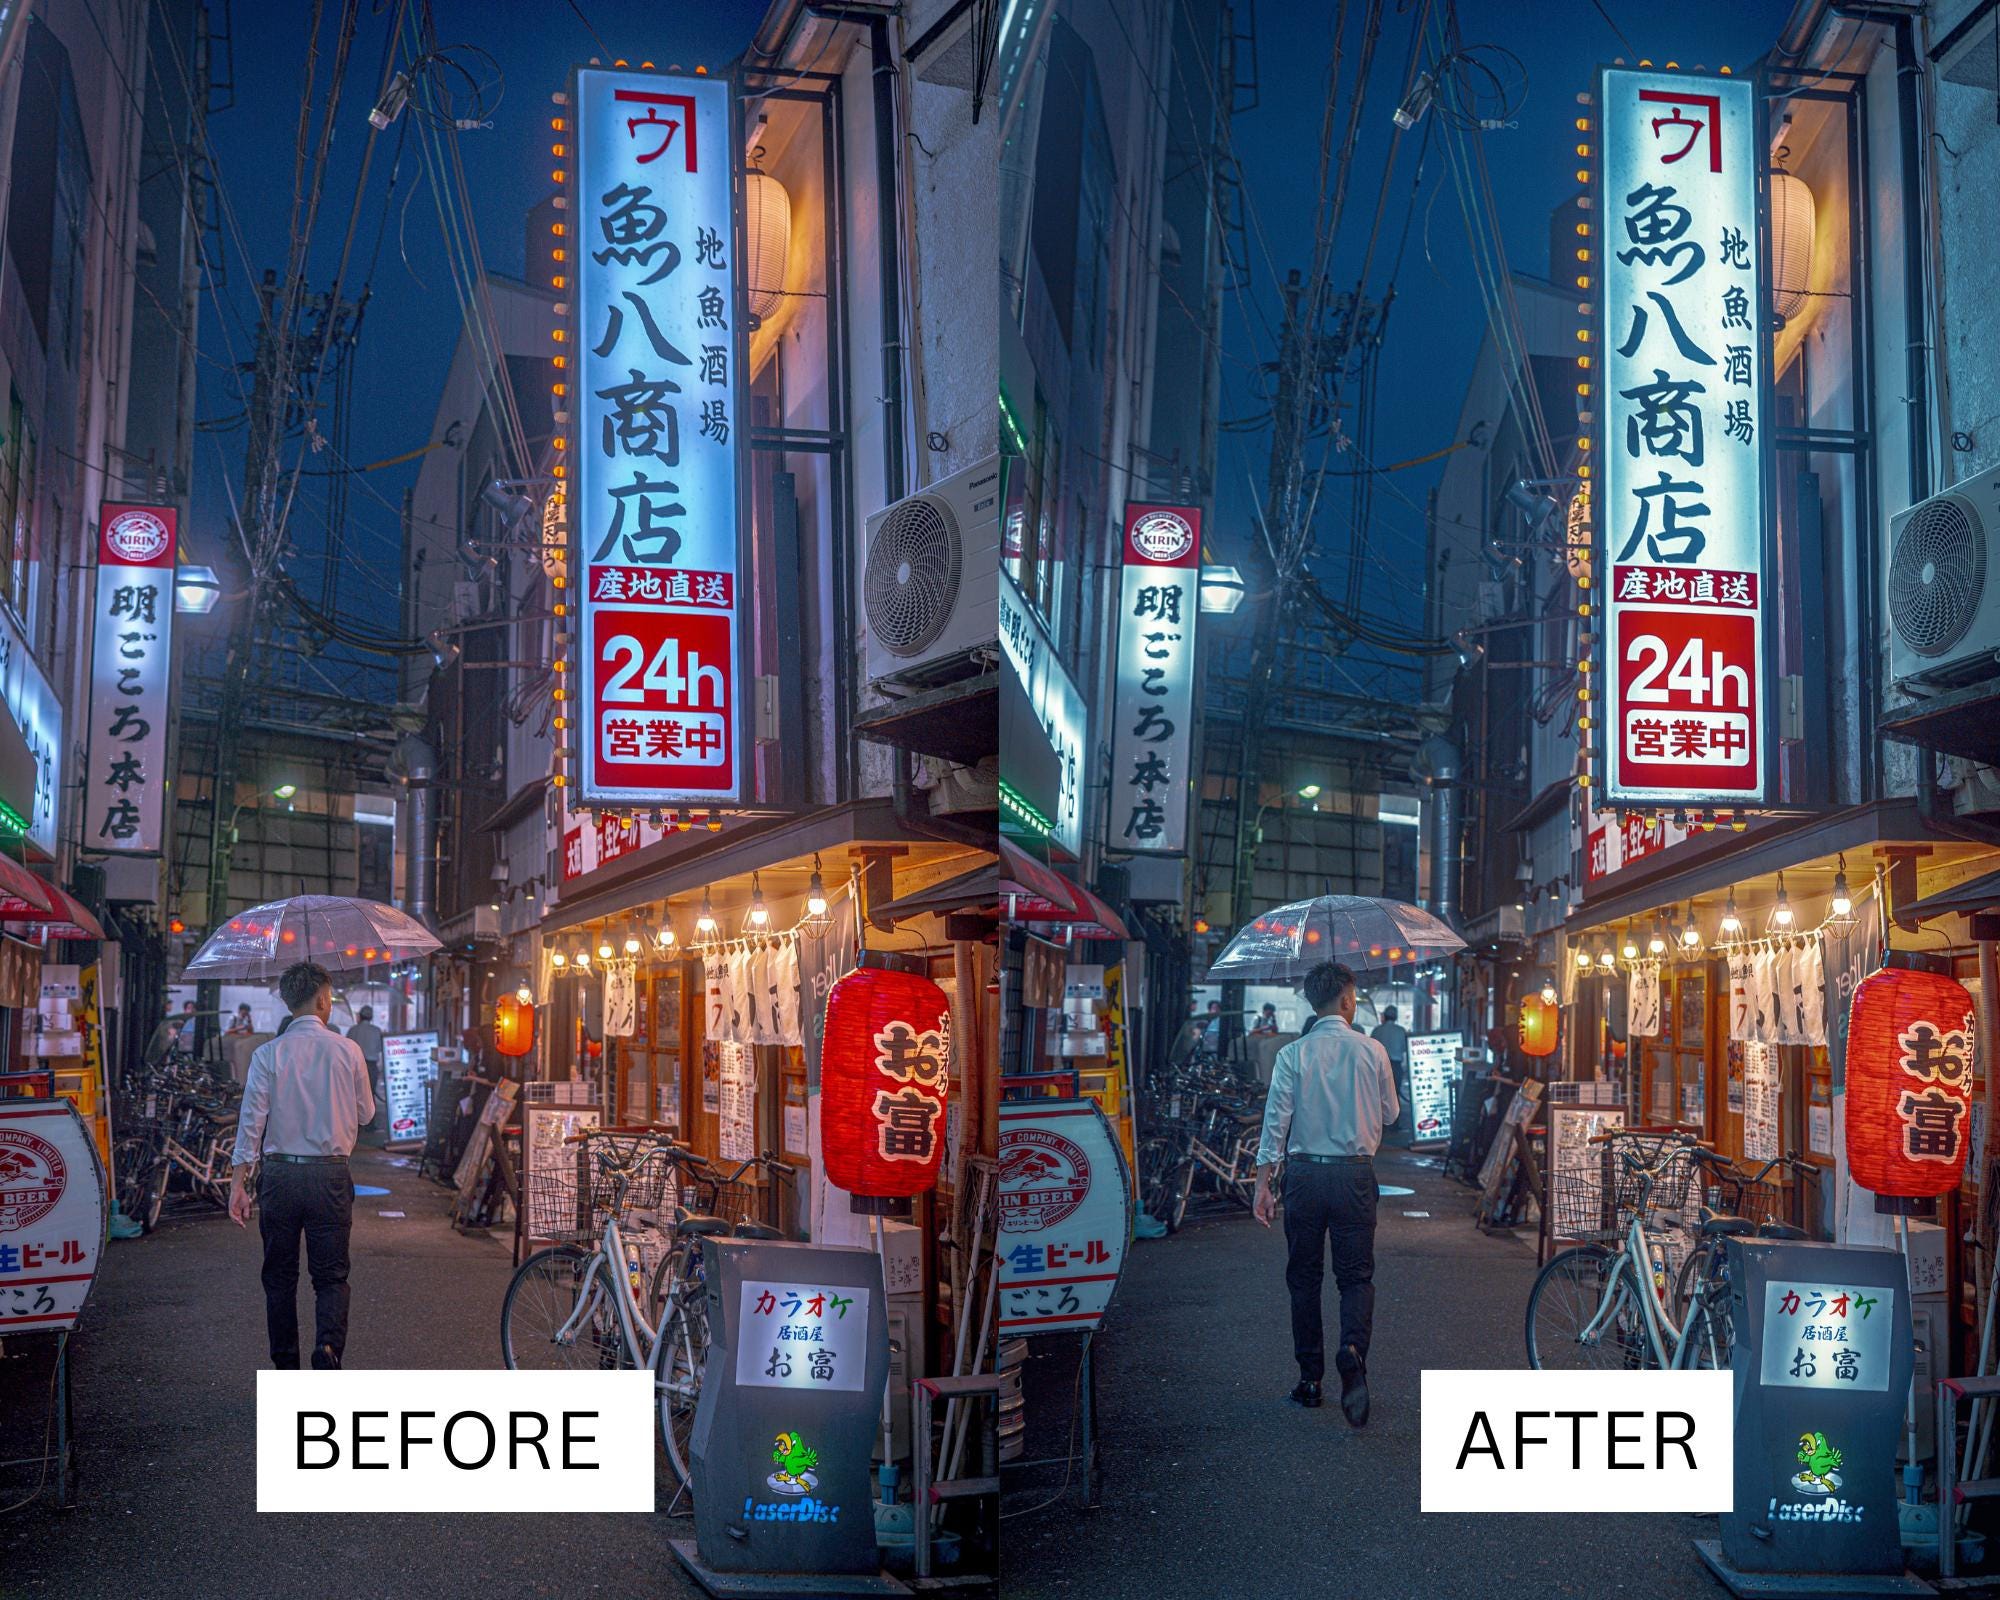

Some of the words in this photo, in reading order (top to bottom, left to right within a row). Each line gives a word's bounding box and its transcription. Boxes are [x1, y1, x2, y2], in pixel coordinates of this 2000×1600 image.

[695, 226, 730, 446] 地魚酒場
[1720, 226, 1755, 446] 地魚酒場
[592, 183, 693, 564] 魚八商店
[1616, 183, 1718, 564] 魚八商店
[119, 535, 155, 546] KIRIN
[1144, 535, 1180, 546] KIRIN
[594, 568, 729, 606] 産地直送
[1618, 568, 1754, 606] 産地直送
[601, 635, 725, 707] 24h
[1626, 635, 1749, 707] 24h
[100, 584, 157, 840] 明ごころ本店
[1123, 584, 1183, 840] 明ごころ本店
[607, 719, 721, 760] 営業中
[1631, 719, 1746, 760] 営業中
[877, 1024, 941, 1160] お富
[1900, 1024, 1966, 1160] お富
[37, 1143, 62, 1172] LIMITED
[1061, 1143, 1086, 1172] LIMITED
[4, 1191, 49, 1204] BEER
[999, 1193, 1020, 1206] IN
[1028, 1191, 1073, 1205] BEER
[999, 1240, 1110, 1274] 生ビール
[753, 1290, 854, 1320] カラオケ
[999, 1285, 1080, 1318] ごころ
[1777, 1290, 1878, 1320] カラオケ
[777, 1325, 825, 1342] 居酒屋
[1801, 1325, 1849, 1342] 居酒屋
[765, 1347, 837, 1382] お富
[1789, 1347, 1861, 1382] お富
[743, 1497, 840, 1523] LaserDisc
[1768, 1497, 1865, 1523] LaserDisc
